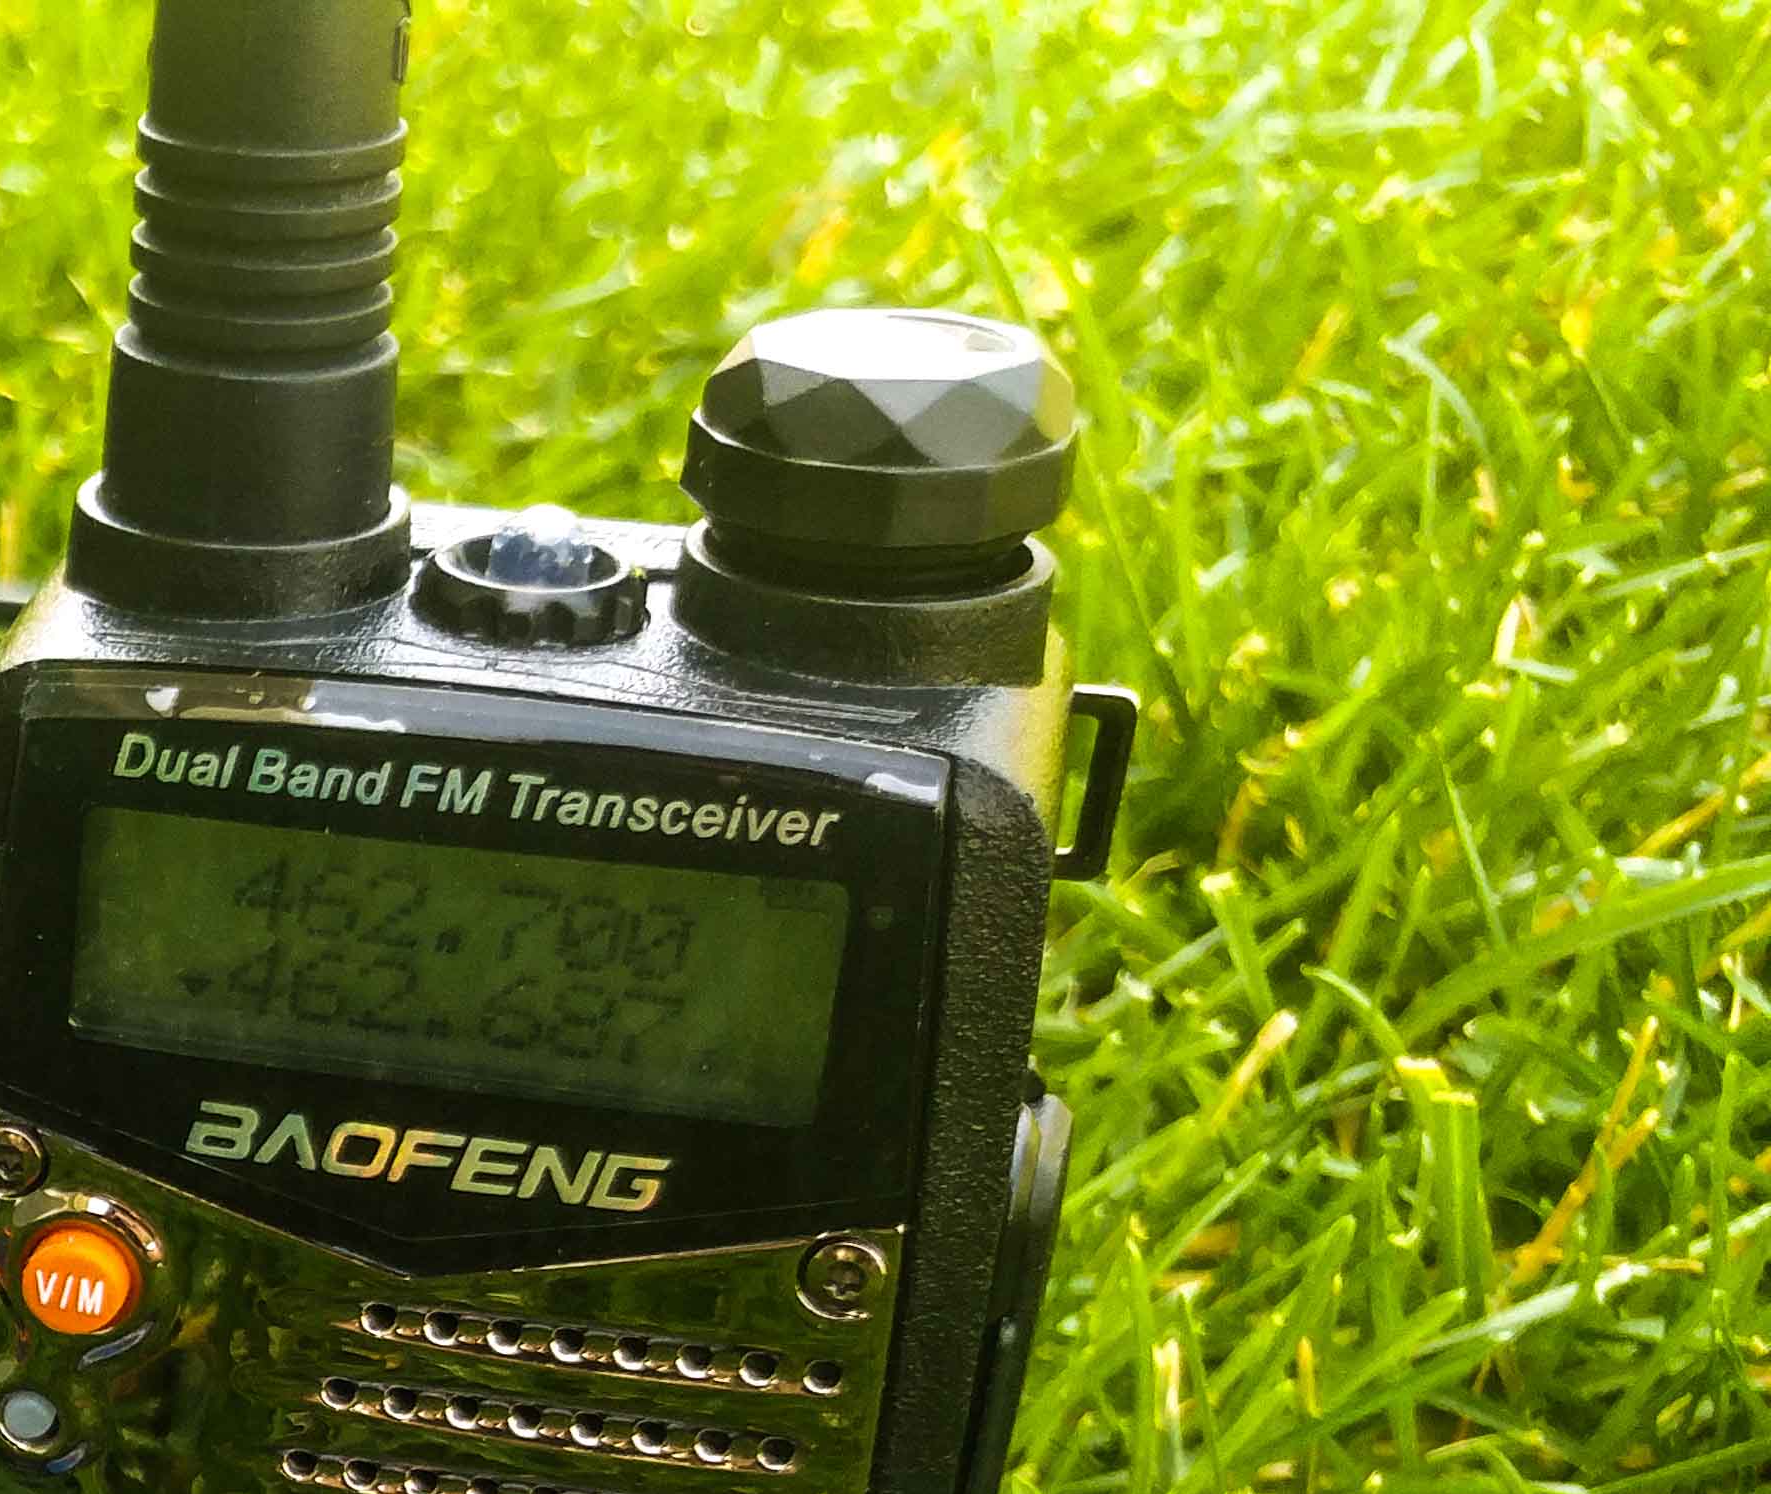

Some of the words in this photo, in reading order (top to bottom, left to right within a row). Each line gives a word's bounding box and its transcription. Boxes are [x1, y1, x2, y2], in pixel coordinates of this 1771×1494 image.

[113, 732, 240, 790] Dual
[246, 747, 393, 807] Band
[399, 761, 493, 815] FM
[507, 772, 842, 848] Transceiver
[184, 1099, 674, 1213] BAOFENG
[33, 1267, 107, 1316] V/M
